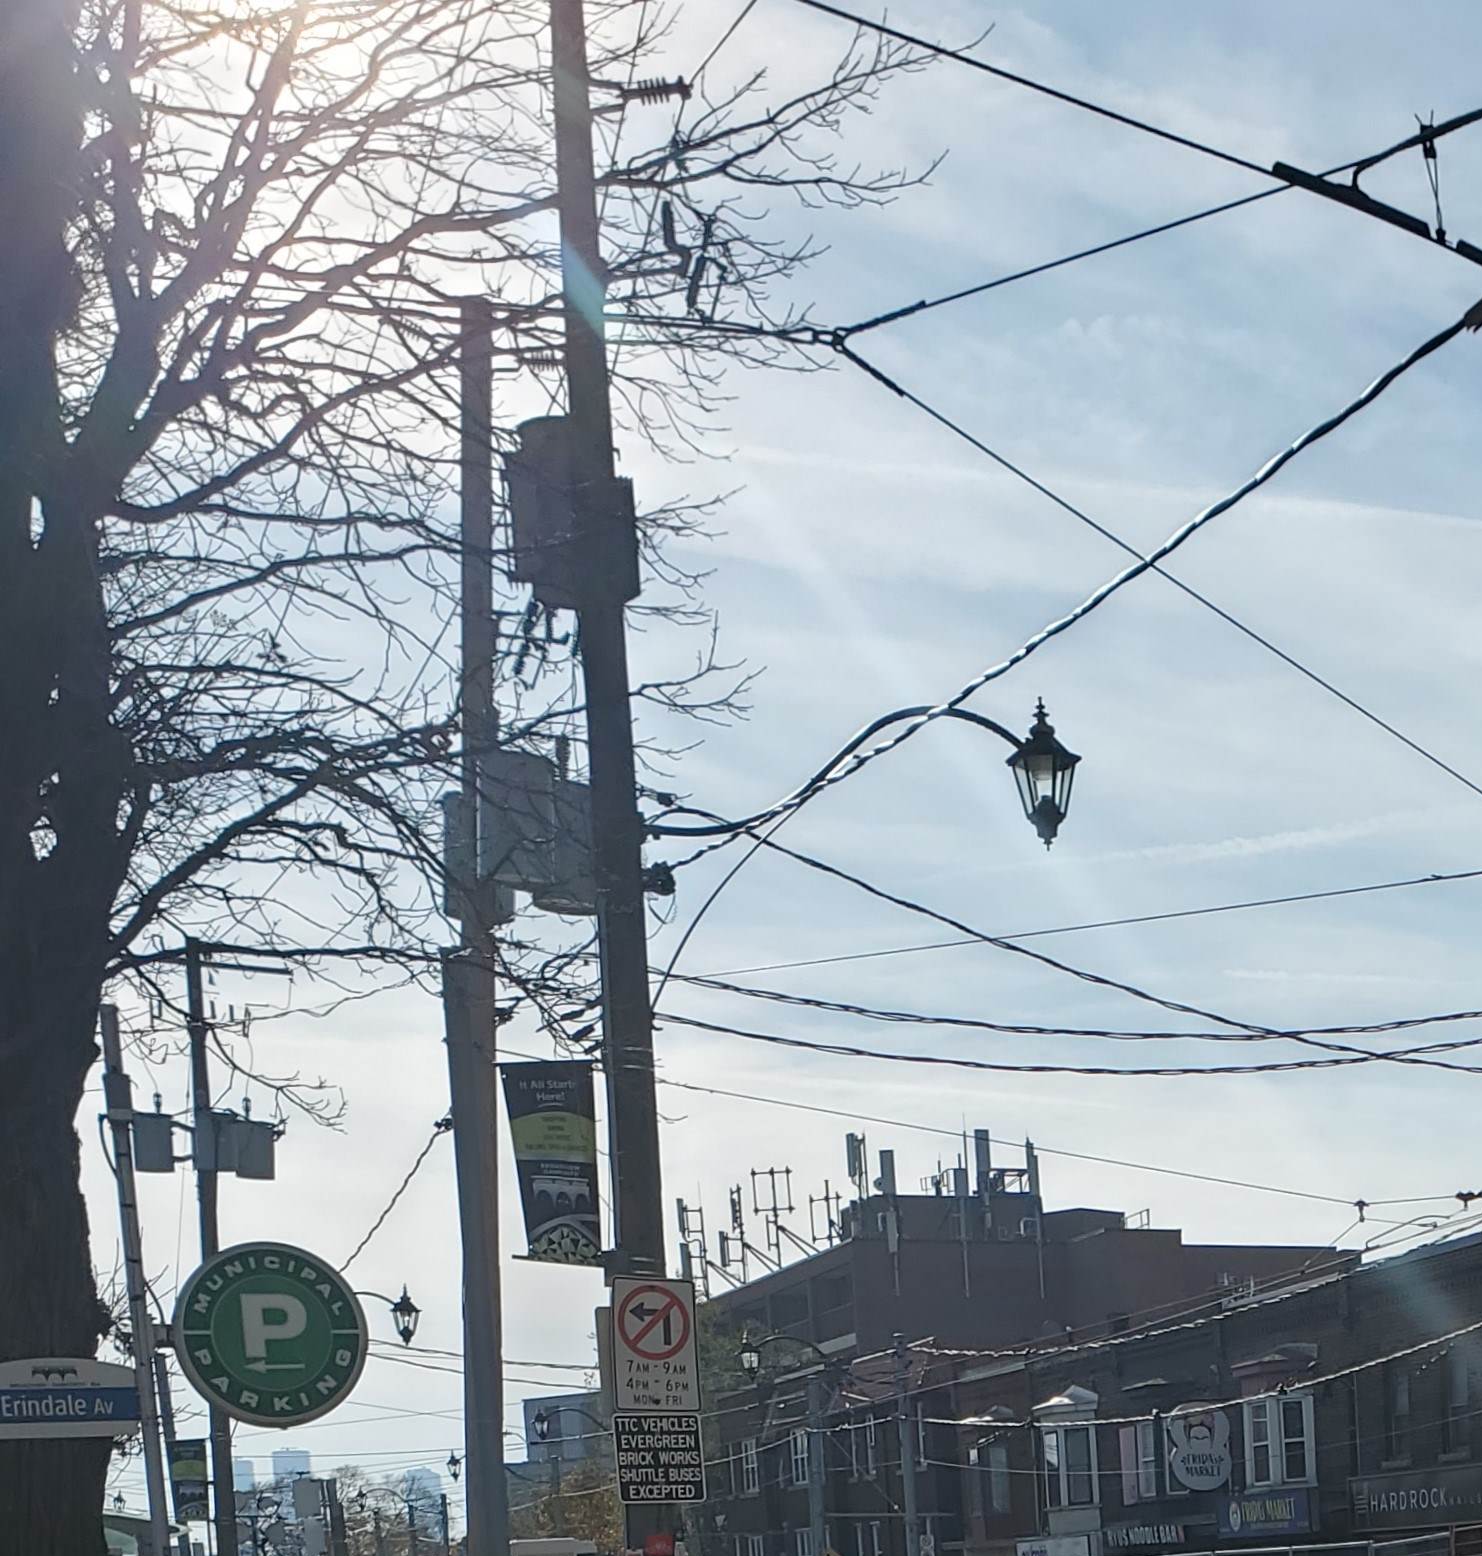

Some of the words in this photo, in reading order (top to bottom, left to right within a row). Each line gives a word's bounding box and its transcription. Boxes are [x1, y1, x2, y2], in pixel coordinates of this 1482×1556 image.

[193, 1254, 345, 1317] MUNICIPAL
[239, 1293, 308, 1359] P
[193, 1348, 352, 1412] PARKING
[0, 1394, 87, 1418] Erindale
[94, 1398, 114, 1416] Av
[665, 1395, 683, 1406] FRI
[616, 1418, 638, 1432] TTC
[641, 1417, 697, 1432] VEHICLES
[621, 1434, 696, 1449] EVERGREEN
[618, 1452, 655, 1466] BRICK
[659, 1451, 700, 1465] WORKS
[620, 1468, 666, 1483] SHUTTLE
[669, 1467, 702, 1482] BUSES
[629, 1485, 695, 1499] EXCEPTED
